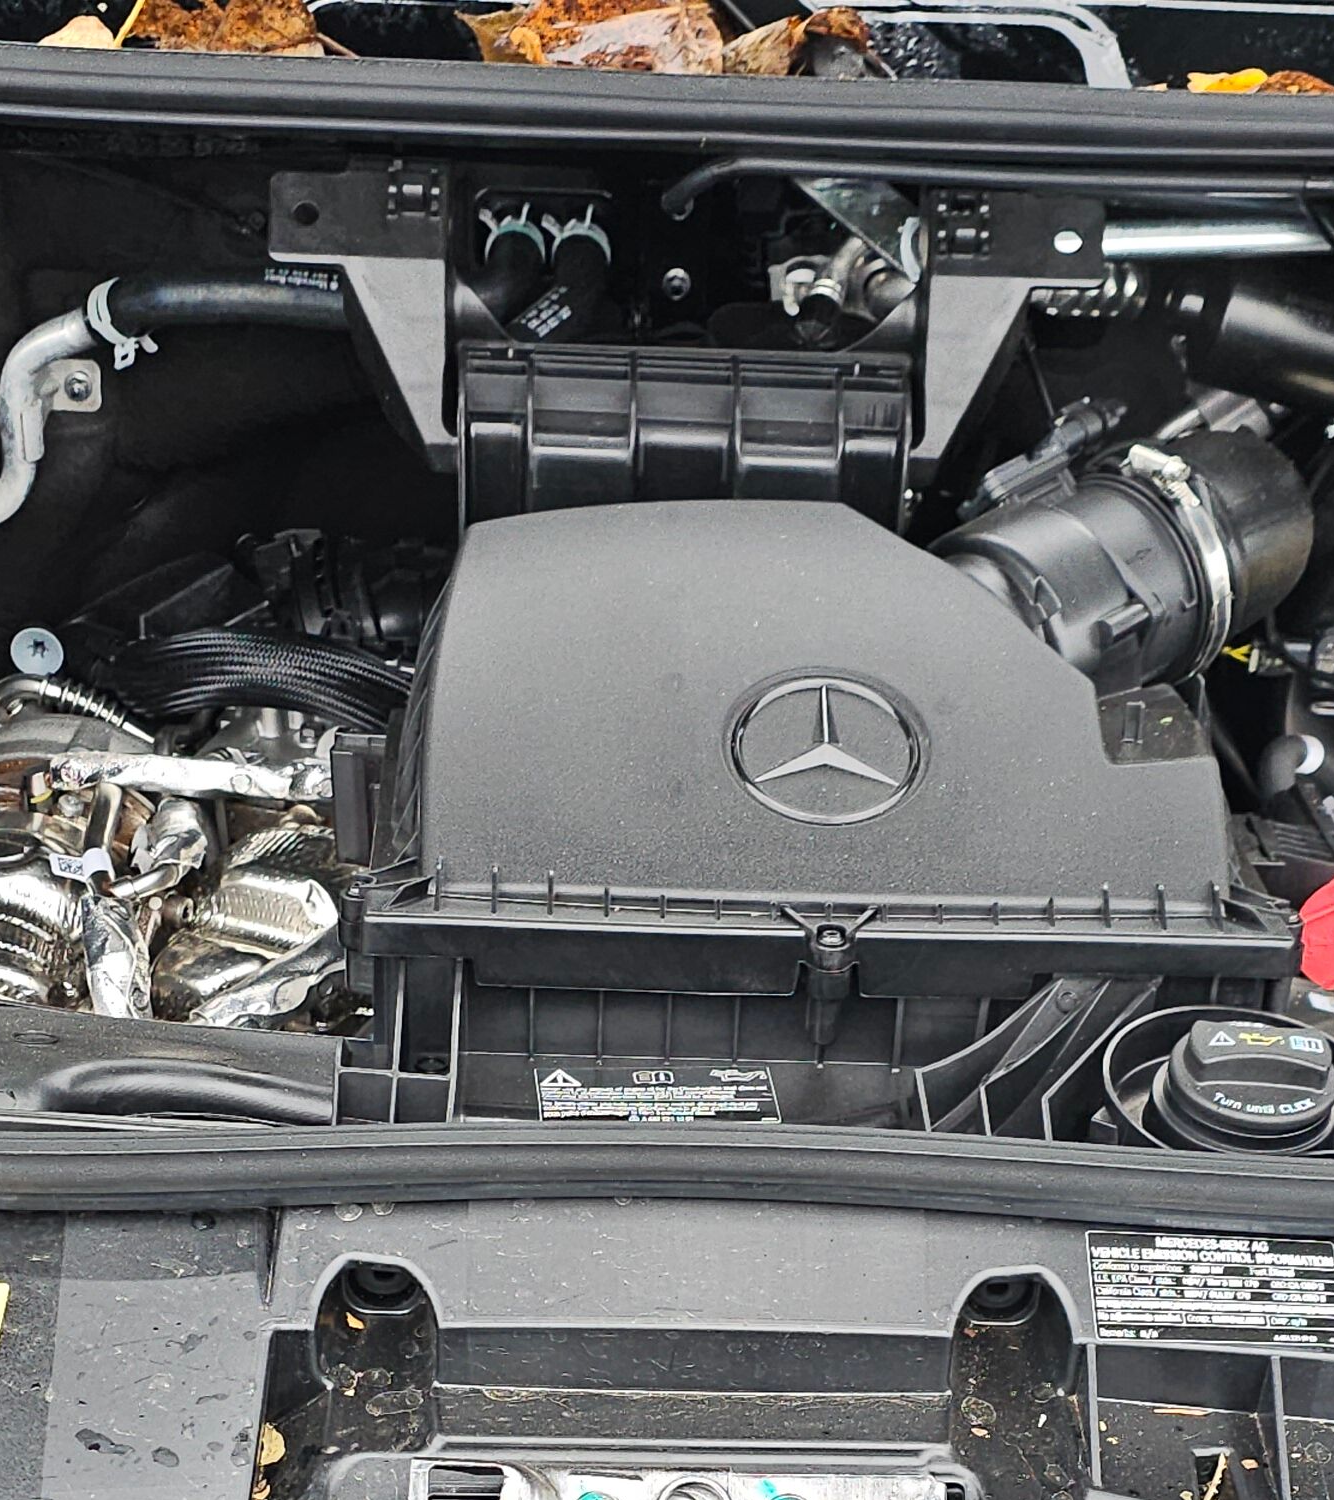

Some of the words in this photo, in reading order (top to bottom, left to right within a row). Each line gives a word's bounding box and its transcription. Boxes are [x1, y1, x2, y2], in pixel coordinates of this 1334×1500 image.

[1213, 1091, 1242, 1111] Turn
[1247, 1104, 1275, 1114] until
[1278, 1098, 1317, 1115] CLICK
[1154, 1236, 1250, 1251] MERCEDES-BENZ
[1250, 1240, 1269, 1251] AG
[1091, 1246, 1140, 1258] VEHICLE
[1141, 1248, 1197, 1261] EMISSION
[1199, 1251, 1254, 1263] CONTROL
[1255, 1253, 1334, 1266] INFORMATION
